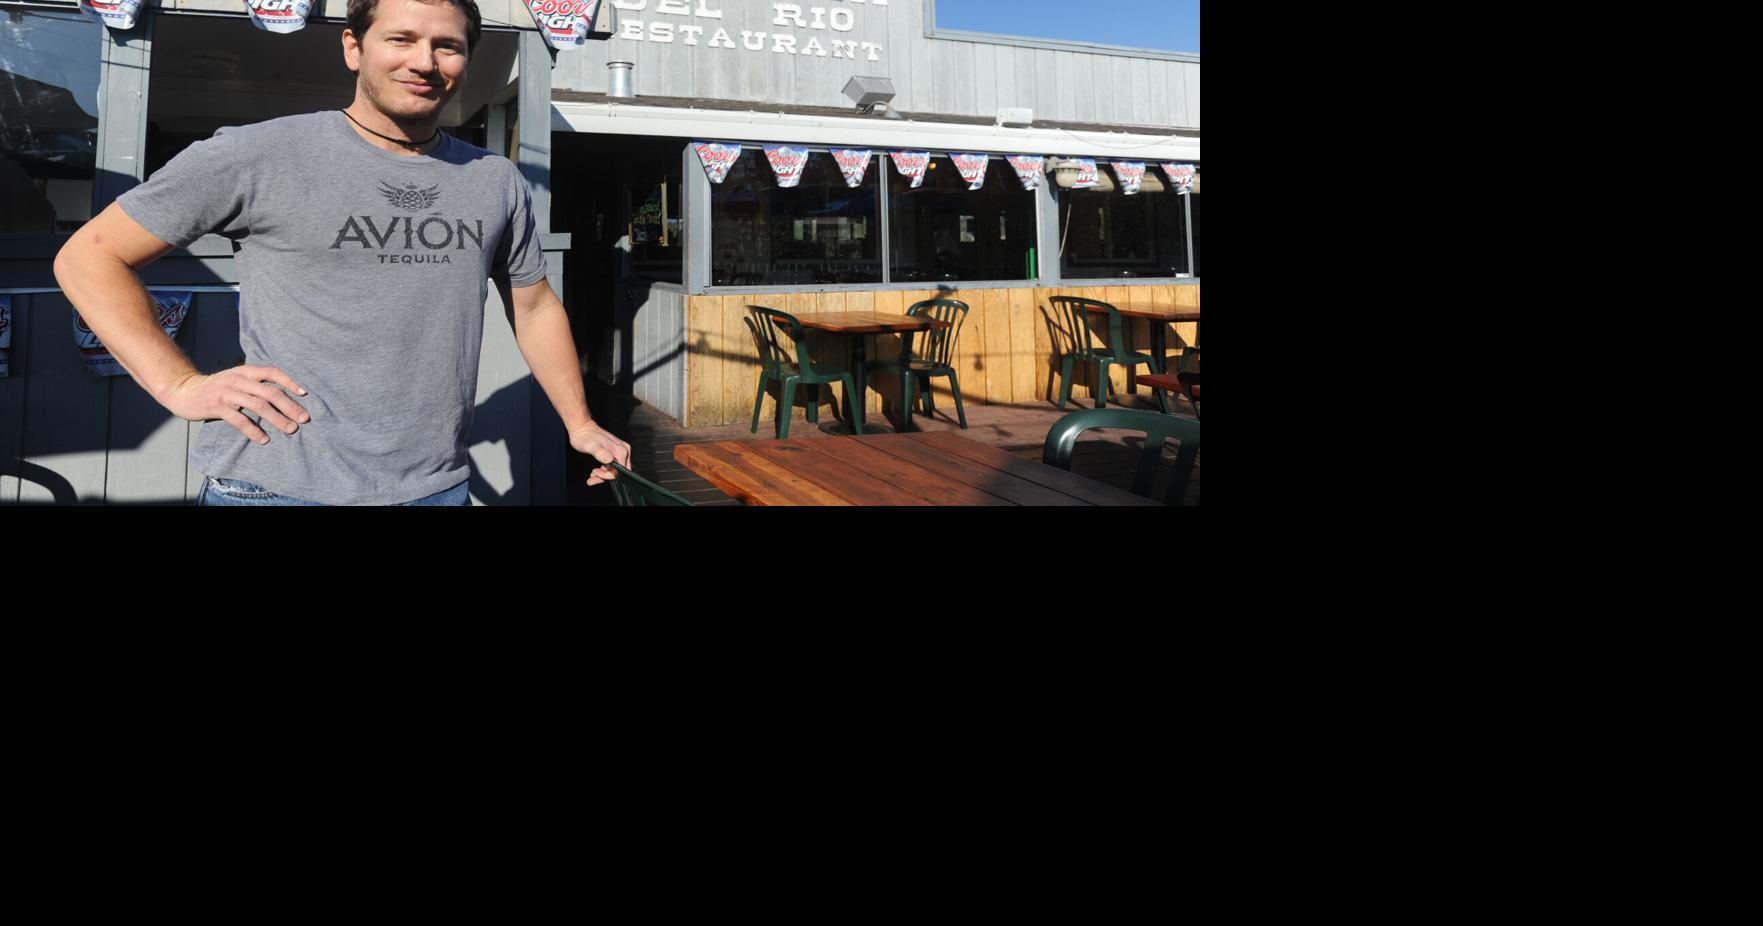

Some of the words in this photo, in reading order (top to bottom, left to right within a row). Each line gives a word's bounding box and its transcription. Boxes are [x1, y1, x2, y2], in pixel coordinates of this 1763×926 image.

[772, 3, 854, 31] RIO
[611, 19, 884, 61] ESTAURANT
[328, 212, 484, 252] AVIÓN
[377, 254, 452, 265] TEQUILA
